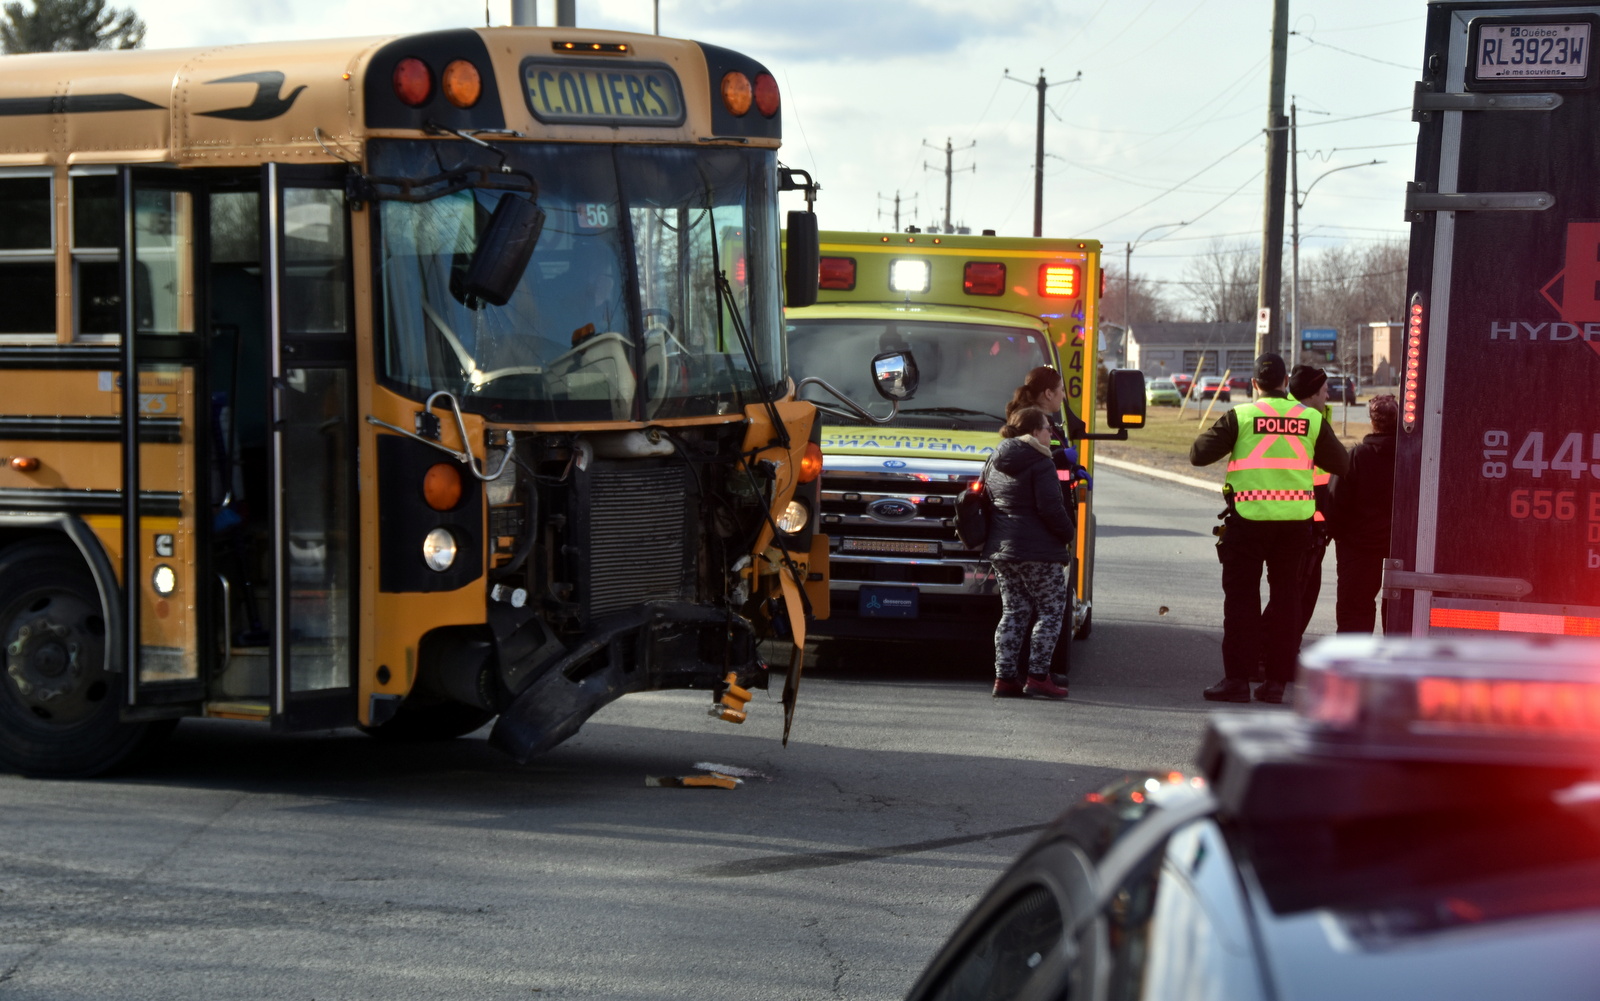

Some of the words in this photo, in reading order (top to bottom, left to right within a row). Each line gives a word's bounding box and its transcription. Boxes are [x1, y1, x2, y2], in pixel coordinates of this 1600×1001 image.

[1521, 28, 1558, 37] Québec
[1482, 37, 1584, 65] RL3923W
[586, 203, 609, 227] 56
[1069, 299, 1085, 398] 4246
[1256, 418, 1307, 434] POLICE
[1482, 430, 1508, 479] 819
[881, 504, 904, 515] Ford
[1510, 489, 1576, 520] 656
